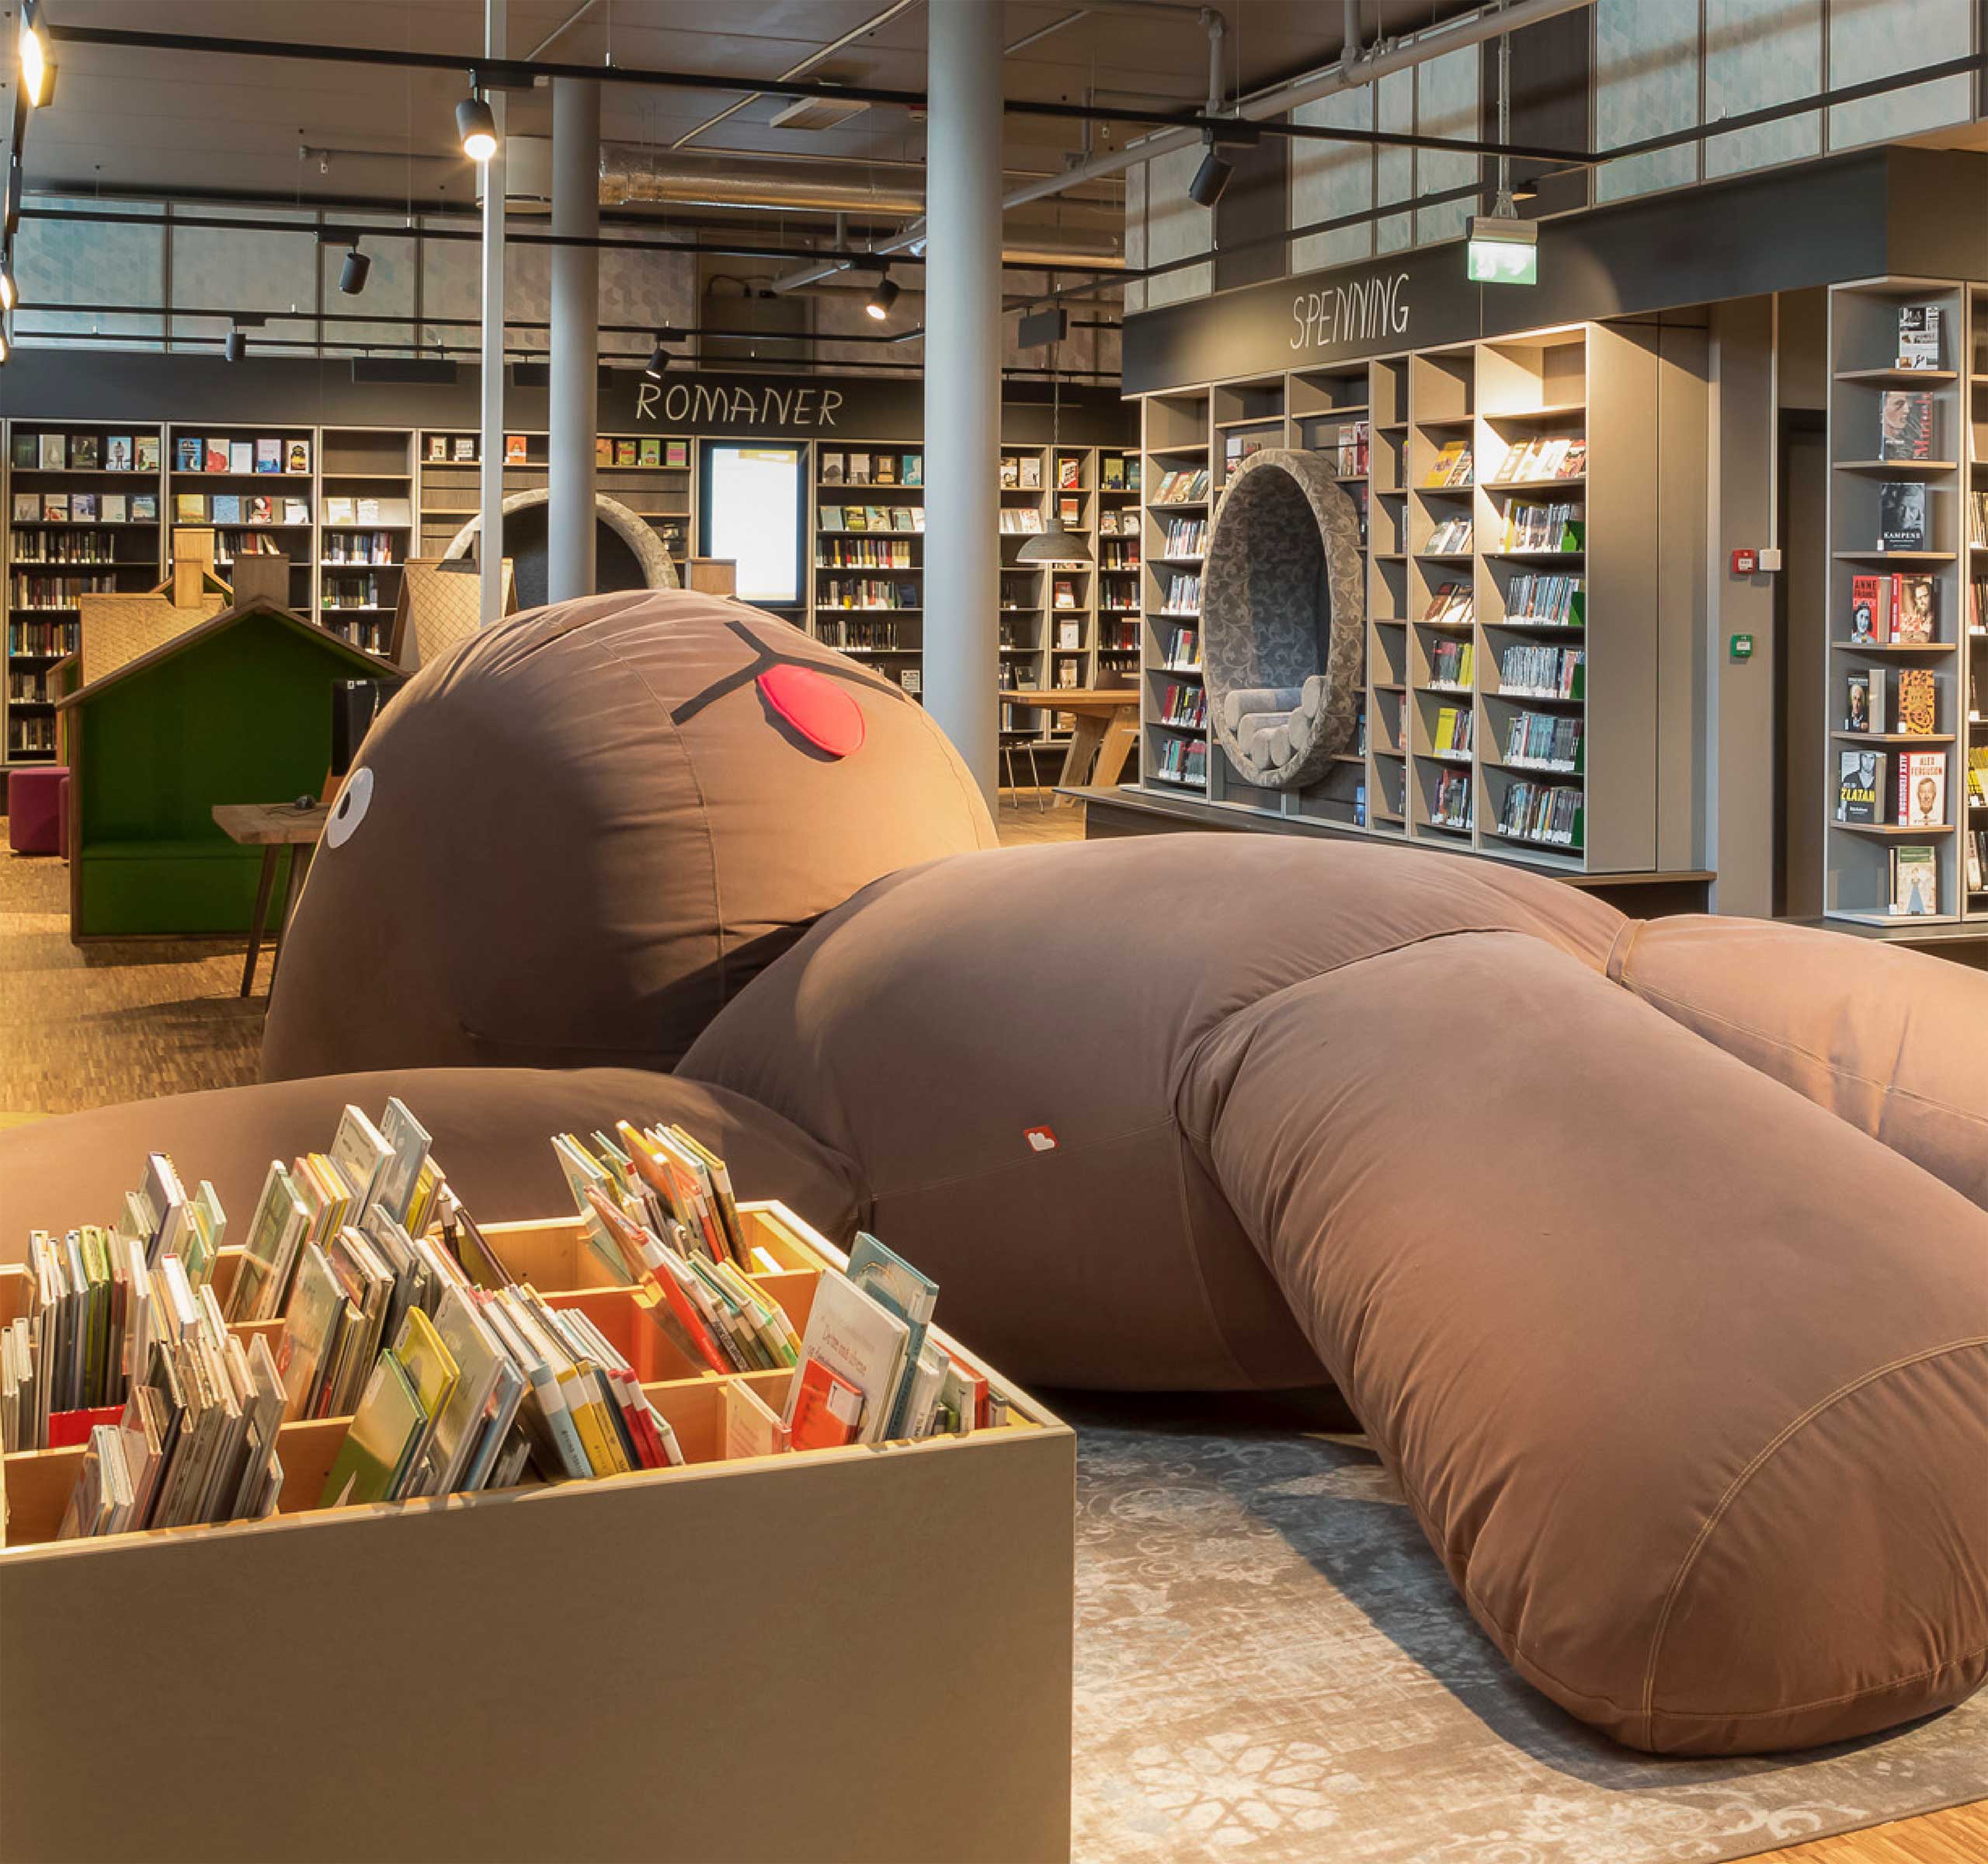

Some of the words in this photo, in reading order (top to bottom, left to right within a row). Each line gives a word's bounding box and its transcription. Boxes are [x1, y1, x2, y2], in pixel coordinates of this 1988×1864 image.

[1290, 273, 1409, 350] SPENNING
[635, 383, 843, 426] ROMANER
[1854, 579, 1876, 589] ANNE
[1840, 788, 1875, 802] ZLATAN
